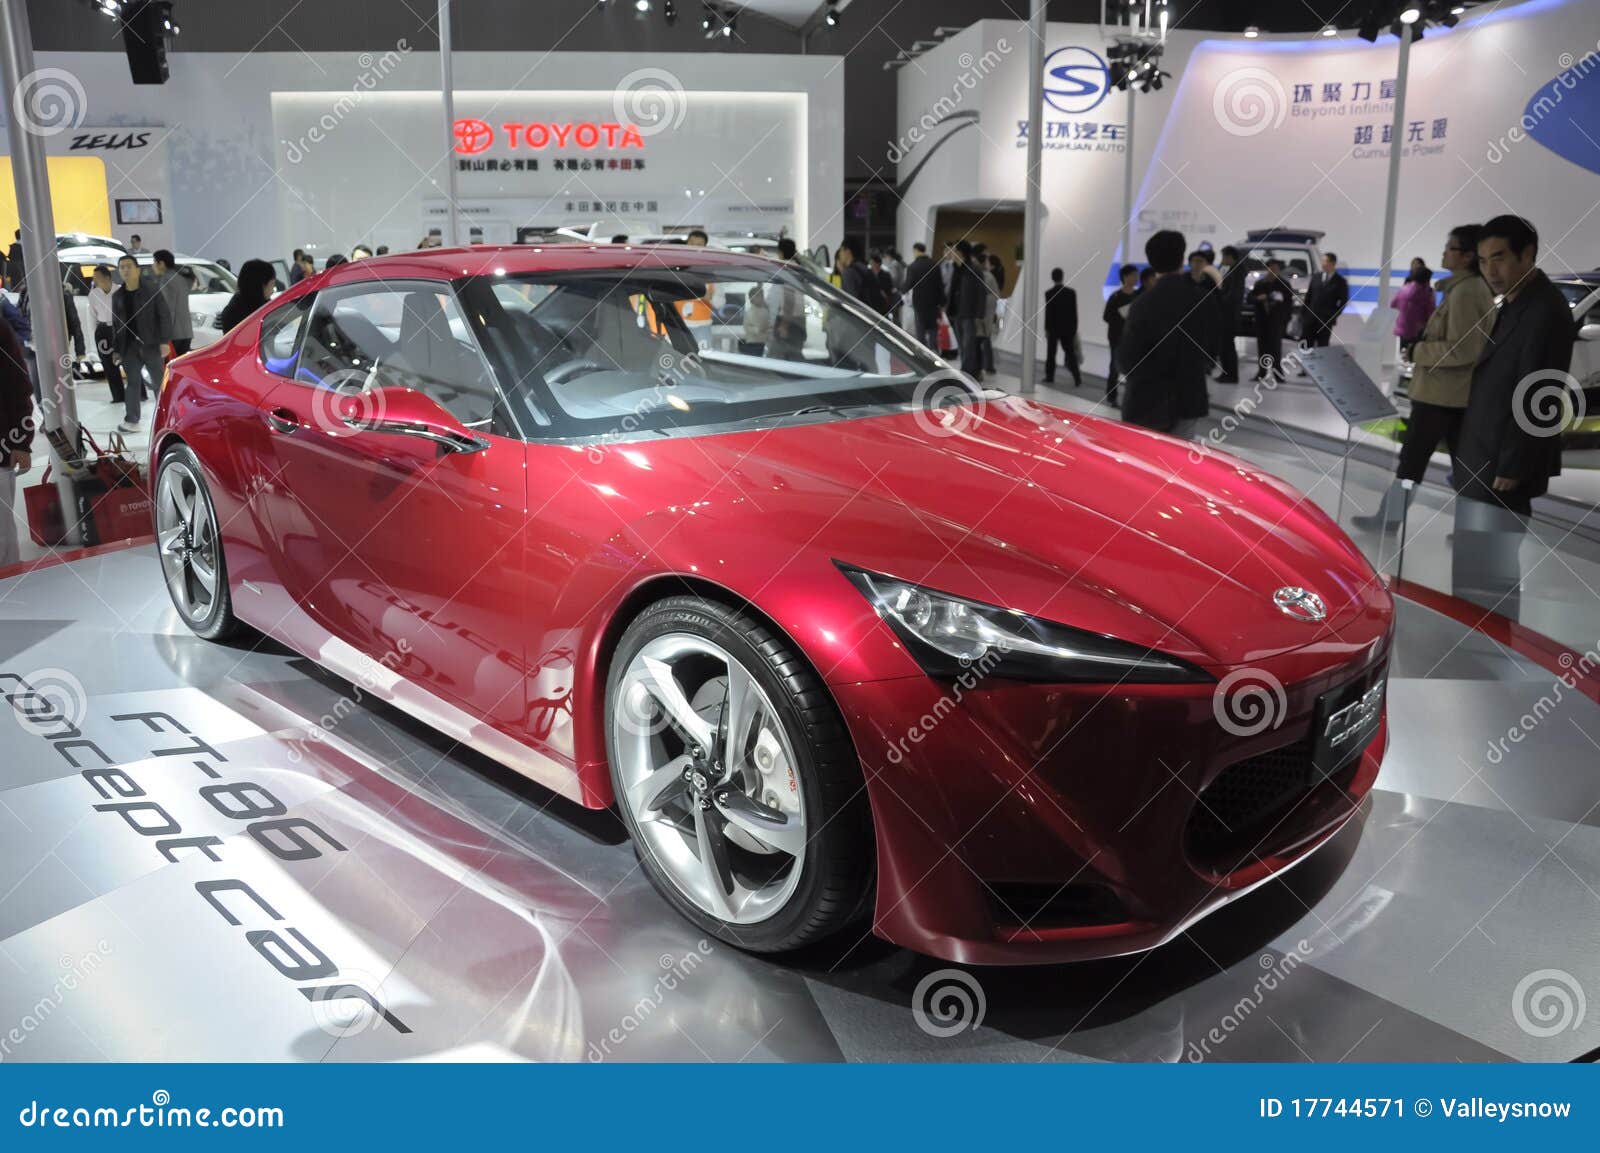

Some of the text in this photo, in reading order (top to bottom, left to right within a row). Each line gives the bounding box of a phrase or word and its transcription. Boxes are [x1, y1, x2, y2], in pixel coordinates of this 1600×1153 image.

[1291, 104, 1345, 120] Beyond
[70, 132, 152, 150] ZELAS
[503, 121, 645, 150] TOYOTA
[1095, 143, 1126, 152] AUTO
[110, 712, 348, 861] FT-86
[195, 879, 413, 1033] car
